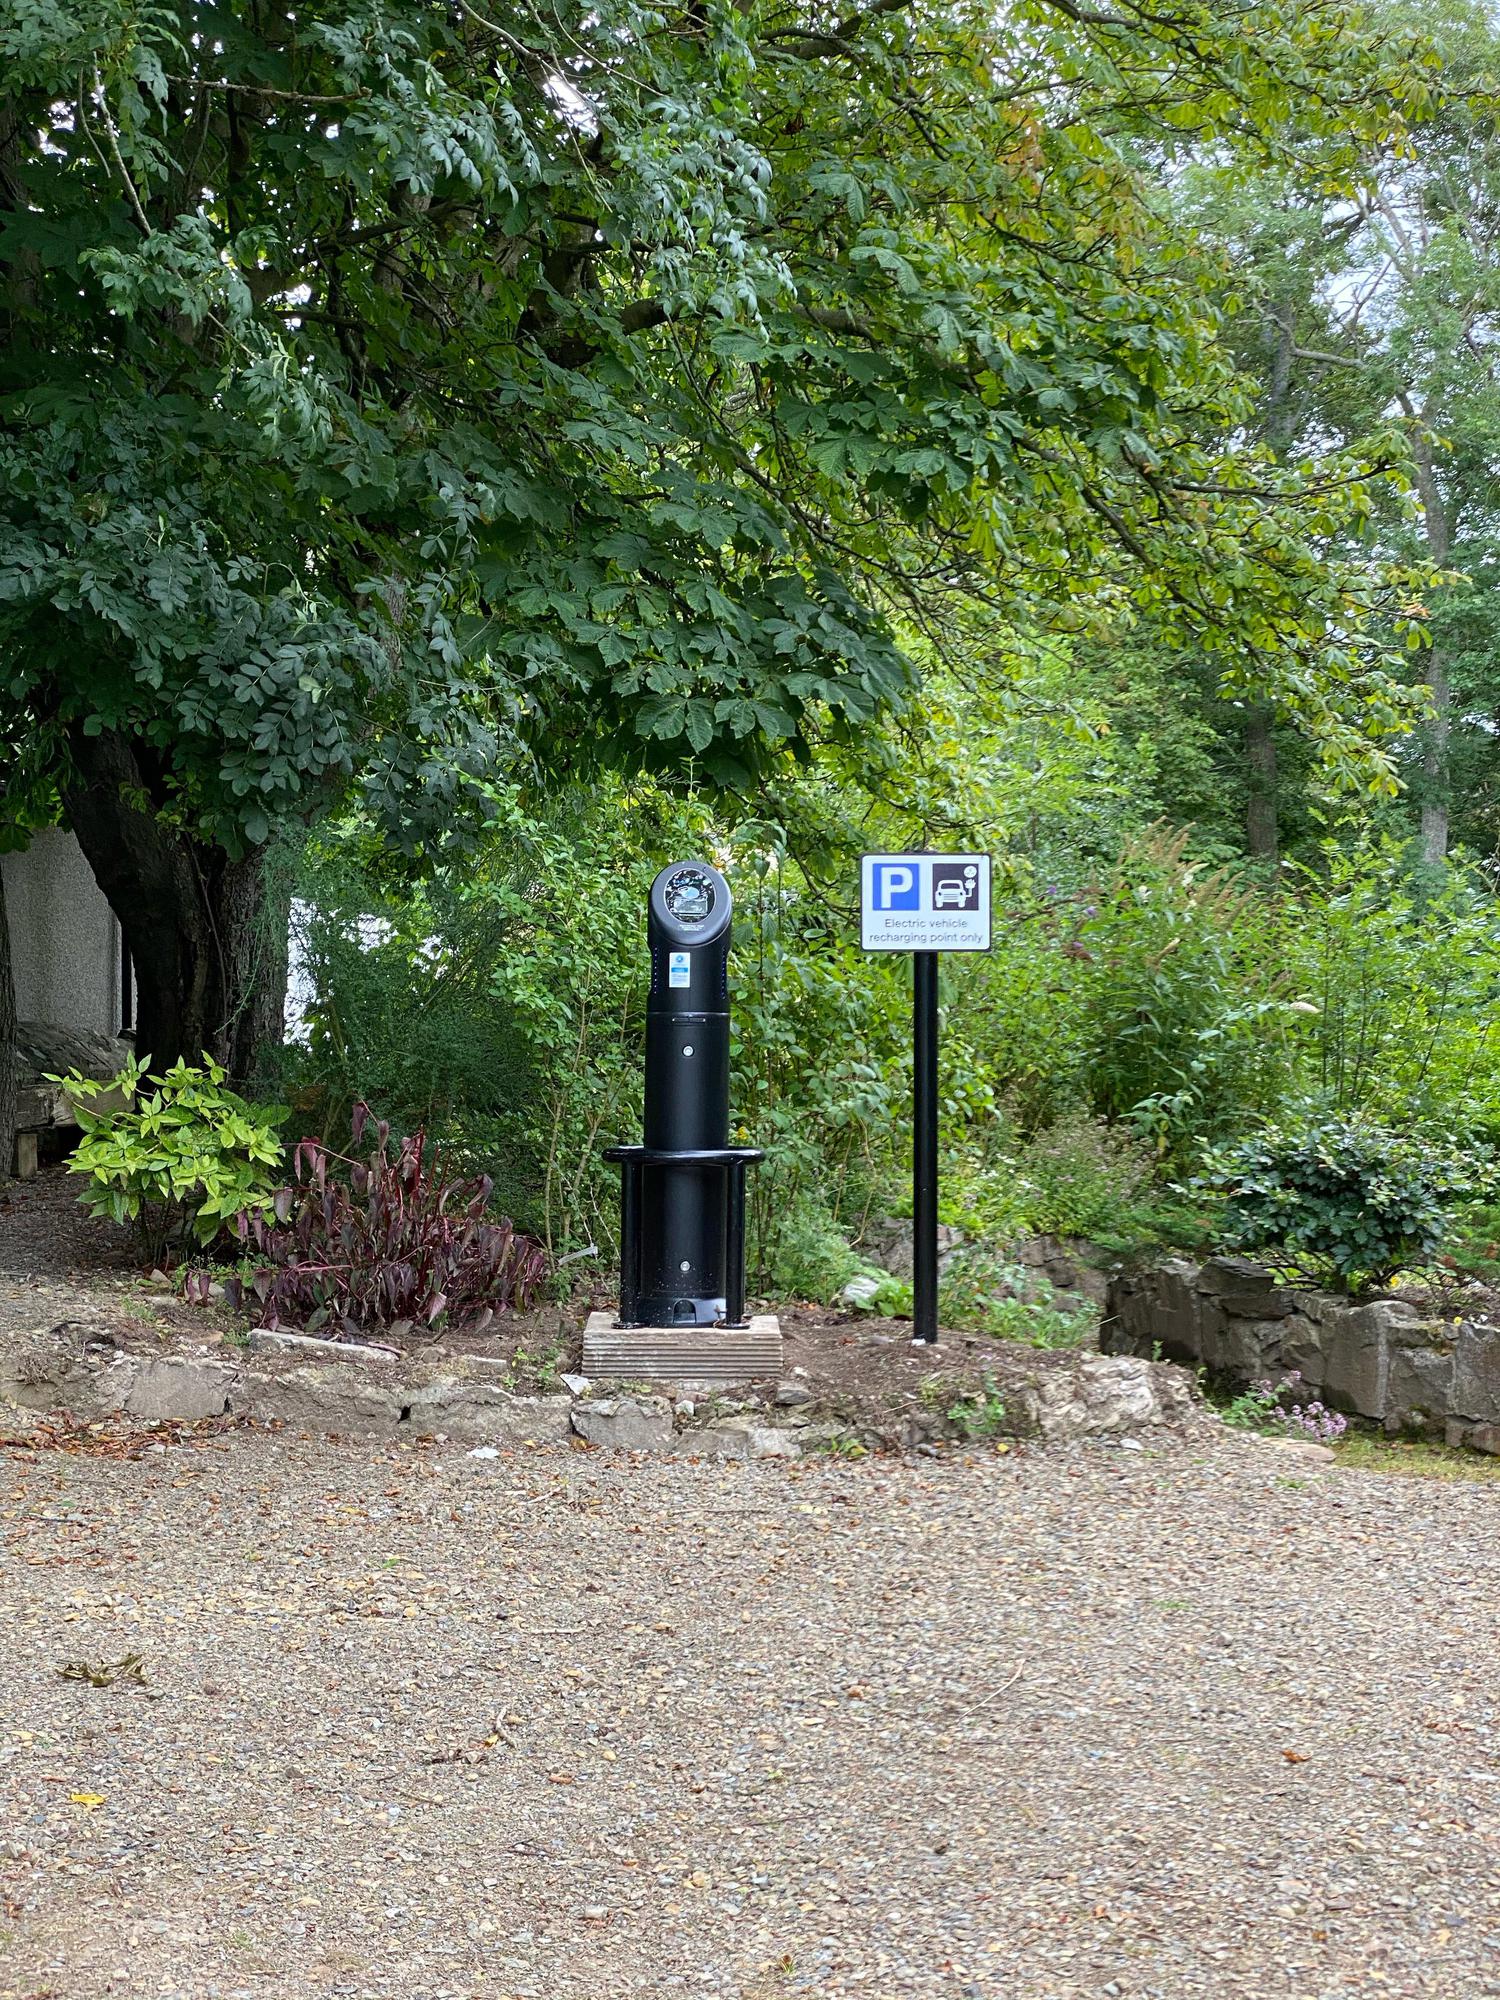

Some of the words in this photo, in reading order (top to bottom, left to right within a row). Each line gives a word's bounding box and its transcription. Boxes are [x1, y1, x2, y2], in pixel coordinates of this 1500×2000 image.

[881, 867, 913, 908] P
[885, 918, 926, 928] Electric
[930, 918, 968, 928] vehicle
[869, 933, 928, 944] recharging
[930, 933, 958, 944] point
[960, 933, 983, 944] only
